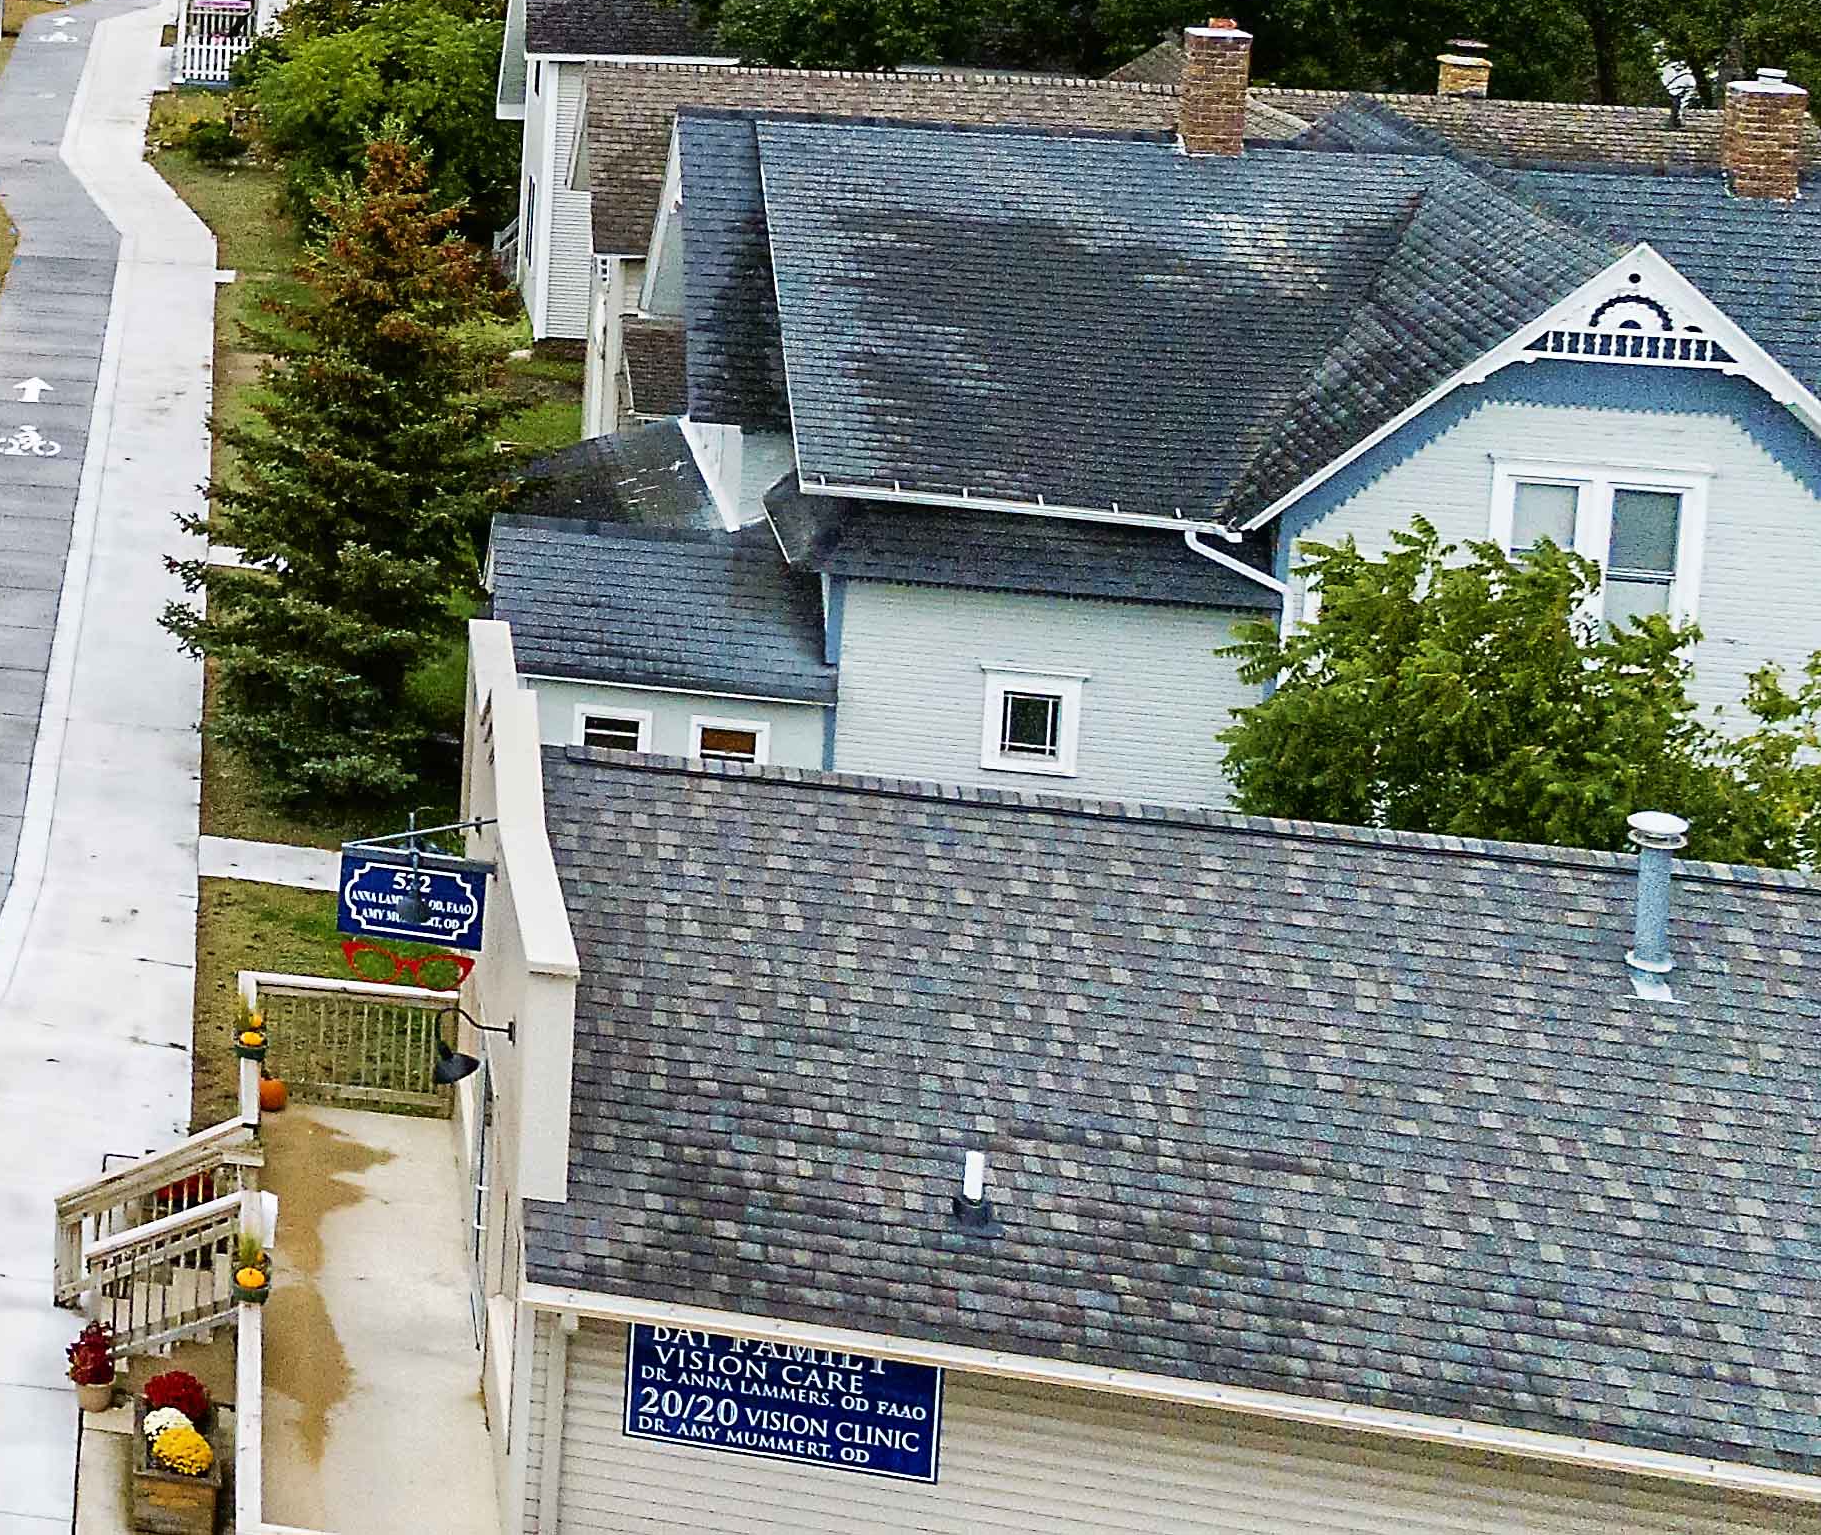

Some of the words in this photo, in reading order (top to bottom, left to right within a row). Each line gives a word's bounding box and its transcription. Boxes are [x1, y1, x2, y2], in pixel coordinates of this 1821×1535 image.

[443, 918, 461, 930] OD
[655, 1345, 767, 1380] VISION
[781, 1365, 864, 1395] CARE
[638, 1386, 739, 1427] 20/20
[745, 1407, 829, 1439] VISION
[835, 1422, 920, 1453] CLINIC
[678, 1371, 734, 1392] ANNA
[841, 1395, 870, 1412] OD
[876, 1400, 927, 1421] FAAO
[676, 1422, 720, 1441] AMY
[840, 1447, 870, 1464] OD
